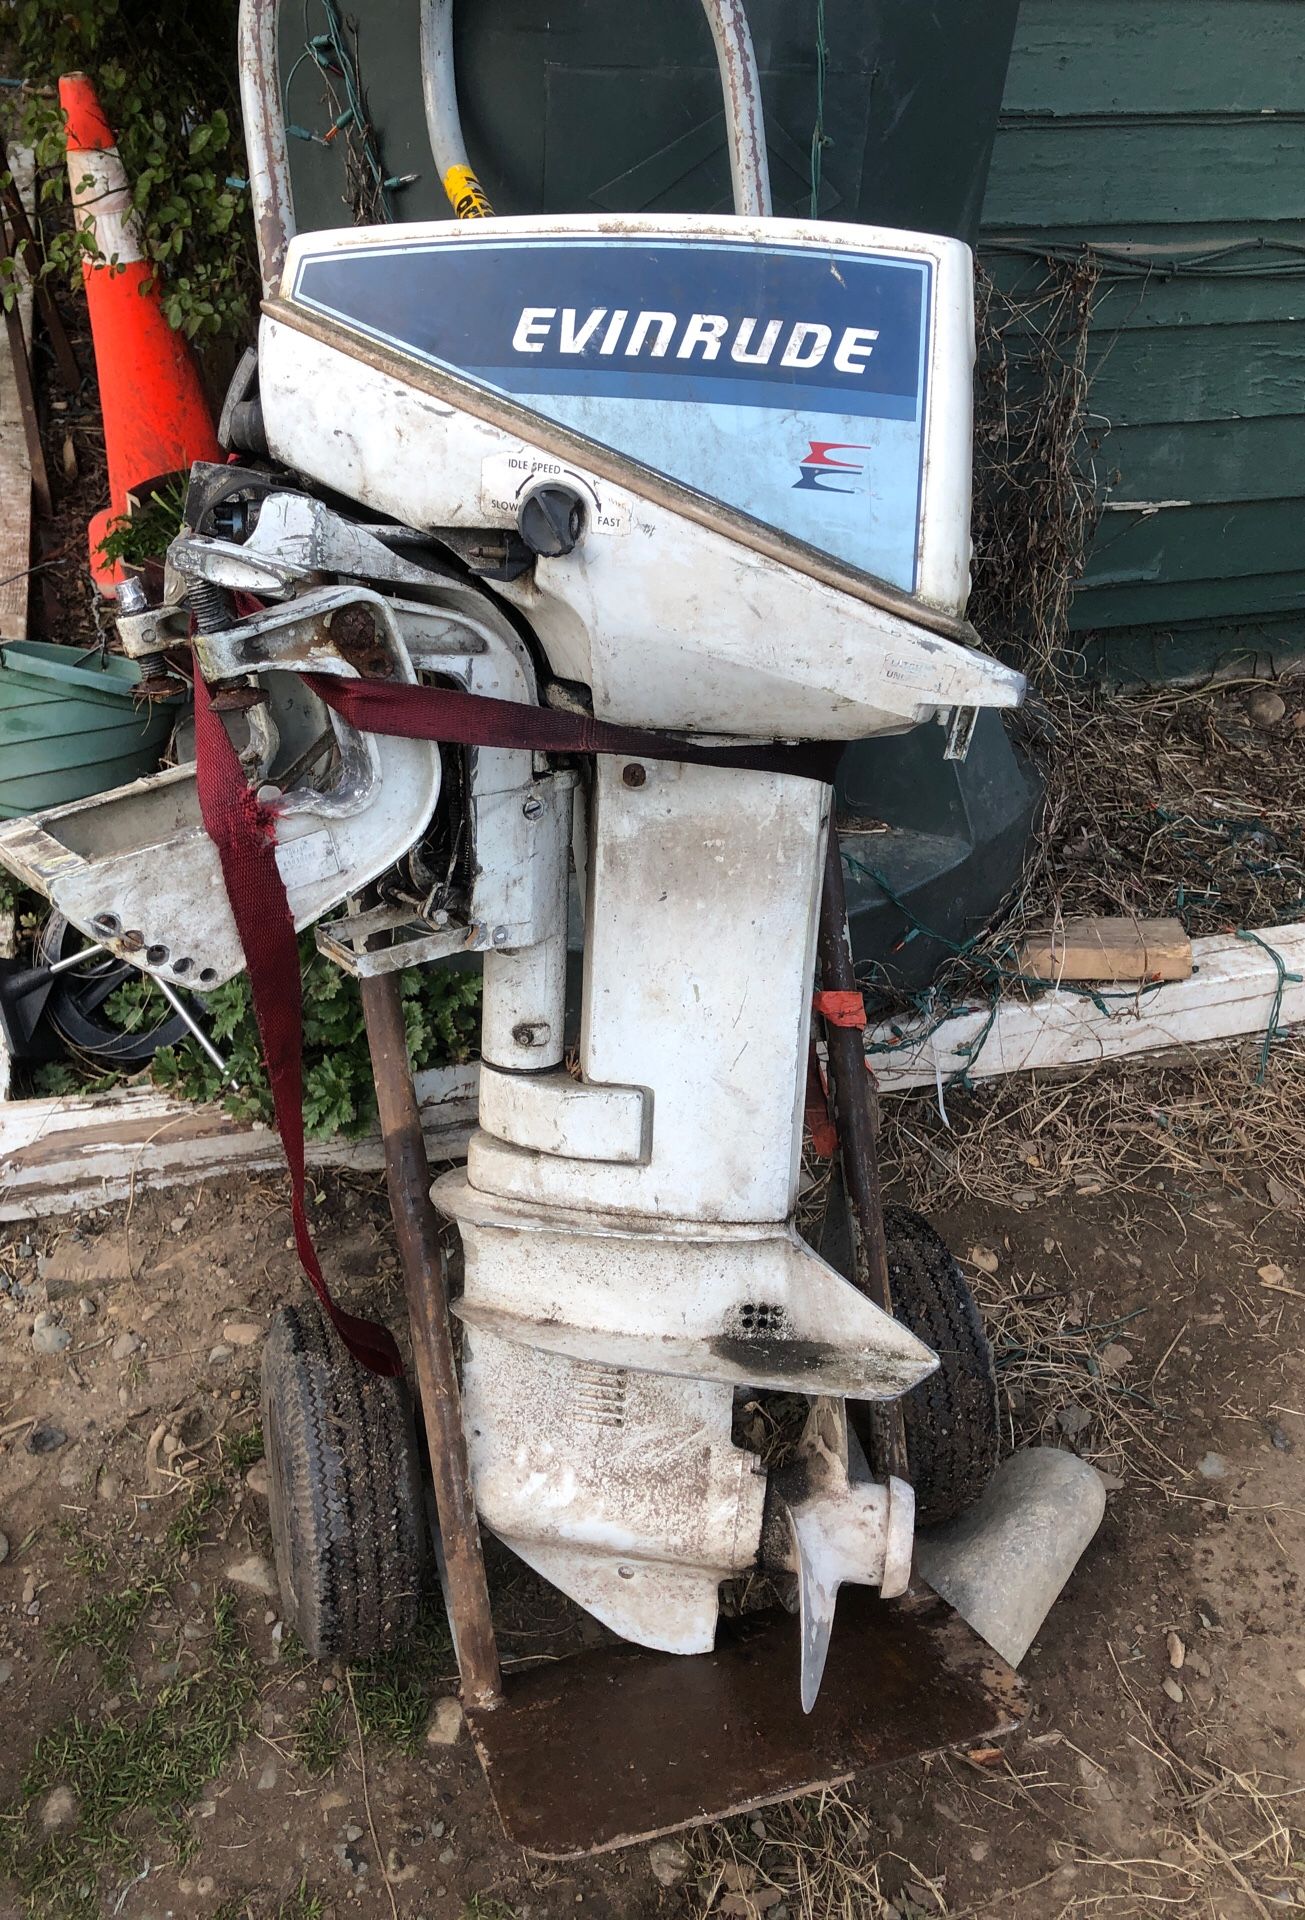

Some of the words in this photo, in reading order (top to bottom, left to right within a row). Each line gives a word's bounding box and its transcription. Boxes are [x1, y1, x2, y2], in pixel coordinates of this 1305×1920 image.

[512, 307, 879, 374] EVINRUDE
[508, 458, 528, 470] IDLE
[531, 462, 561, 474] SPEED
[491, 500, 518, 511] SLOW
[597, 516, 621, 528] FAST
